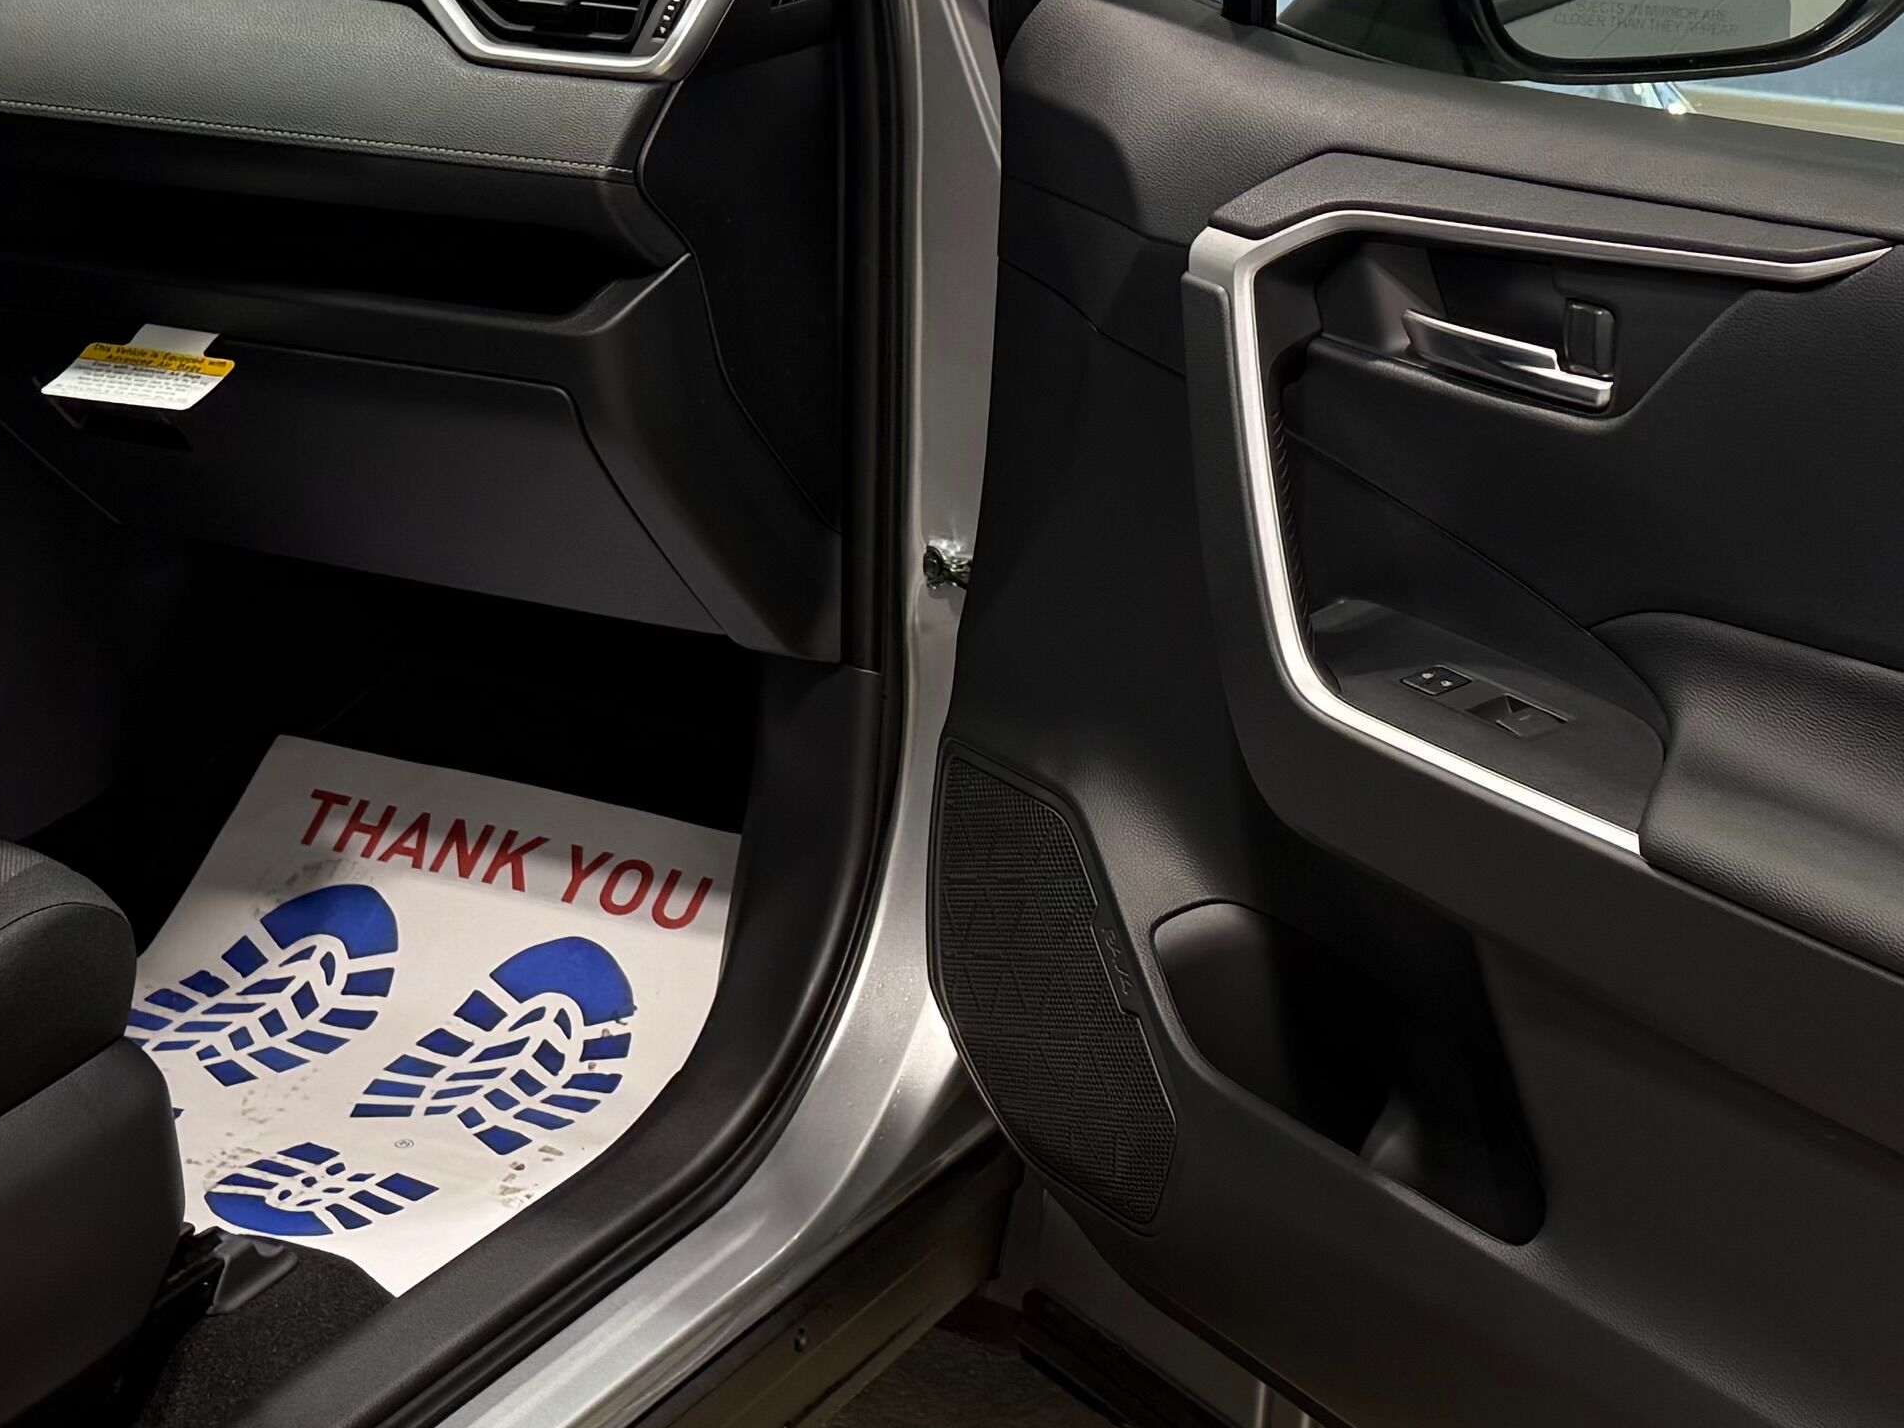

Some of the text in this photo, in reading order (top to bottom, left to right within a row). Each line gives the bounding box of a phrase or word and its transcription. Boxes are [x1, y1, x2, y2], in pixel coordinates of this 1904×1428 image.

[1553, 12, 1605, 27] CLOSER
[300, 789, 714, 930] THANK YOU
